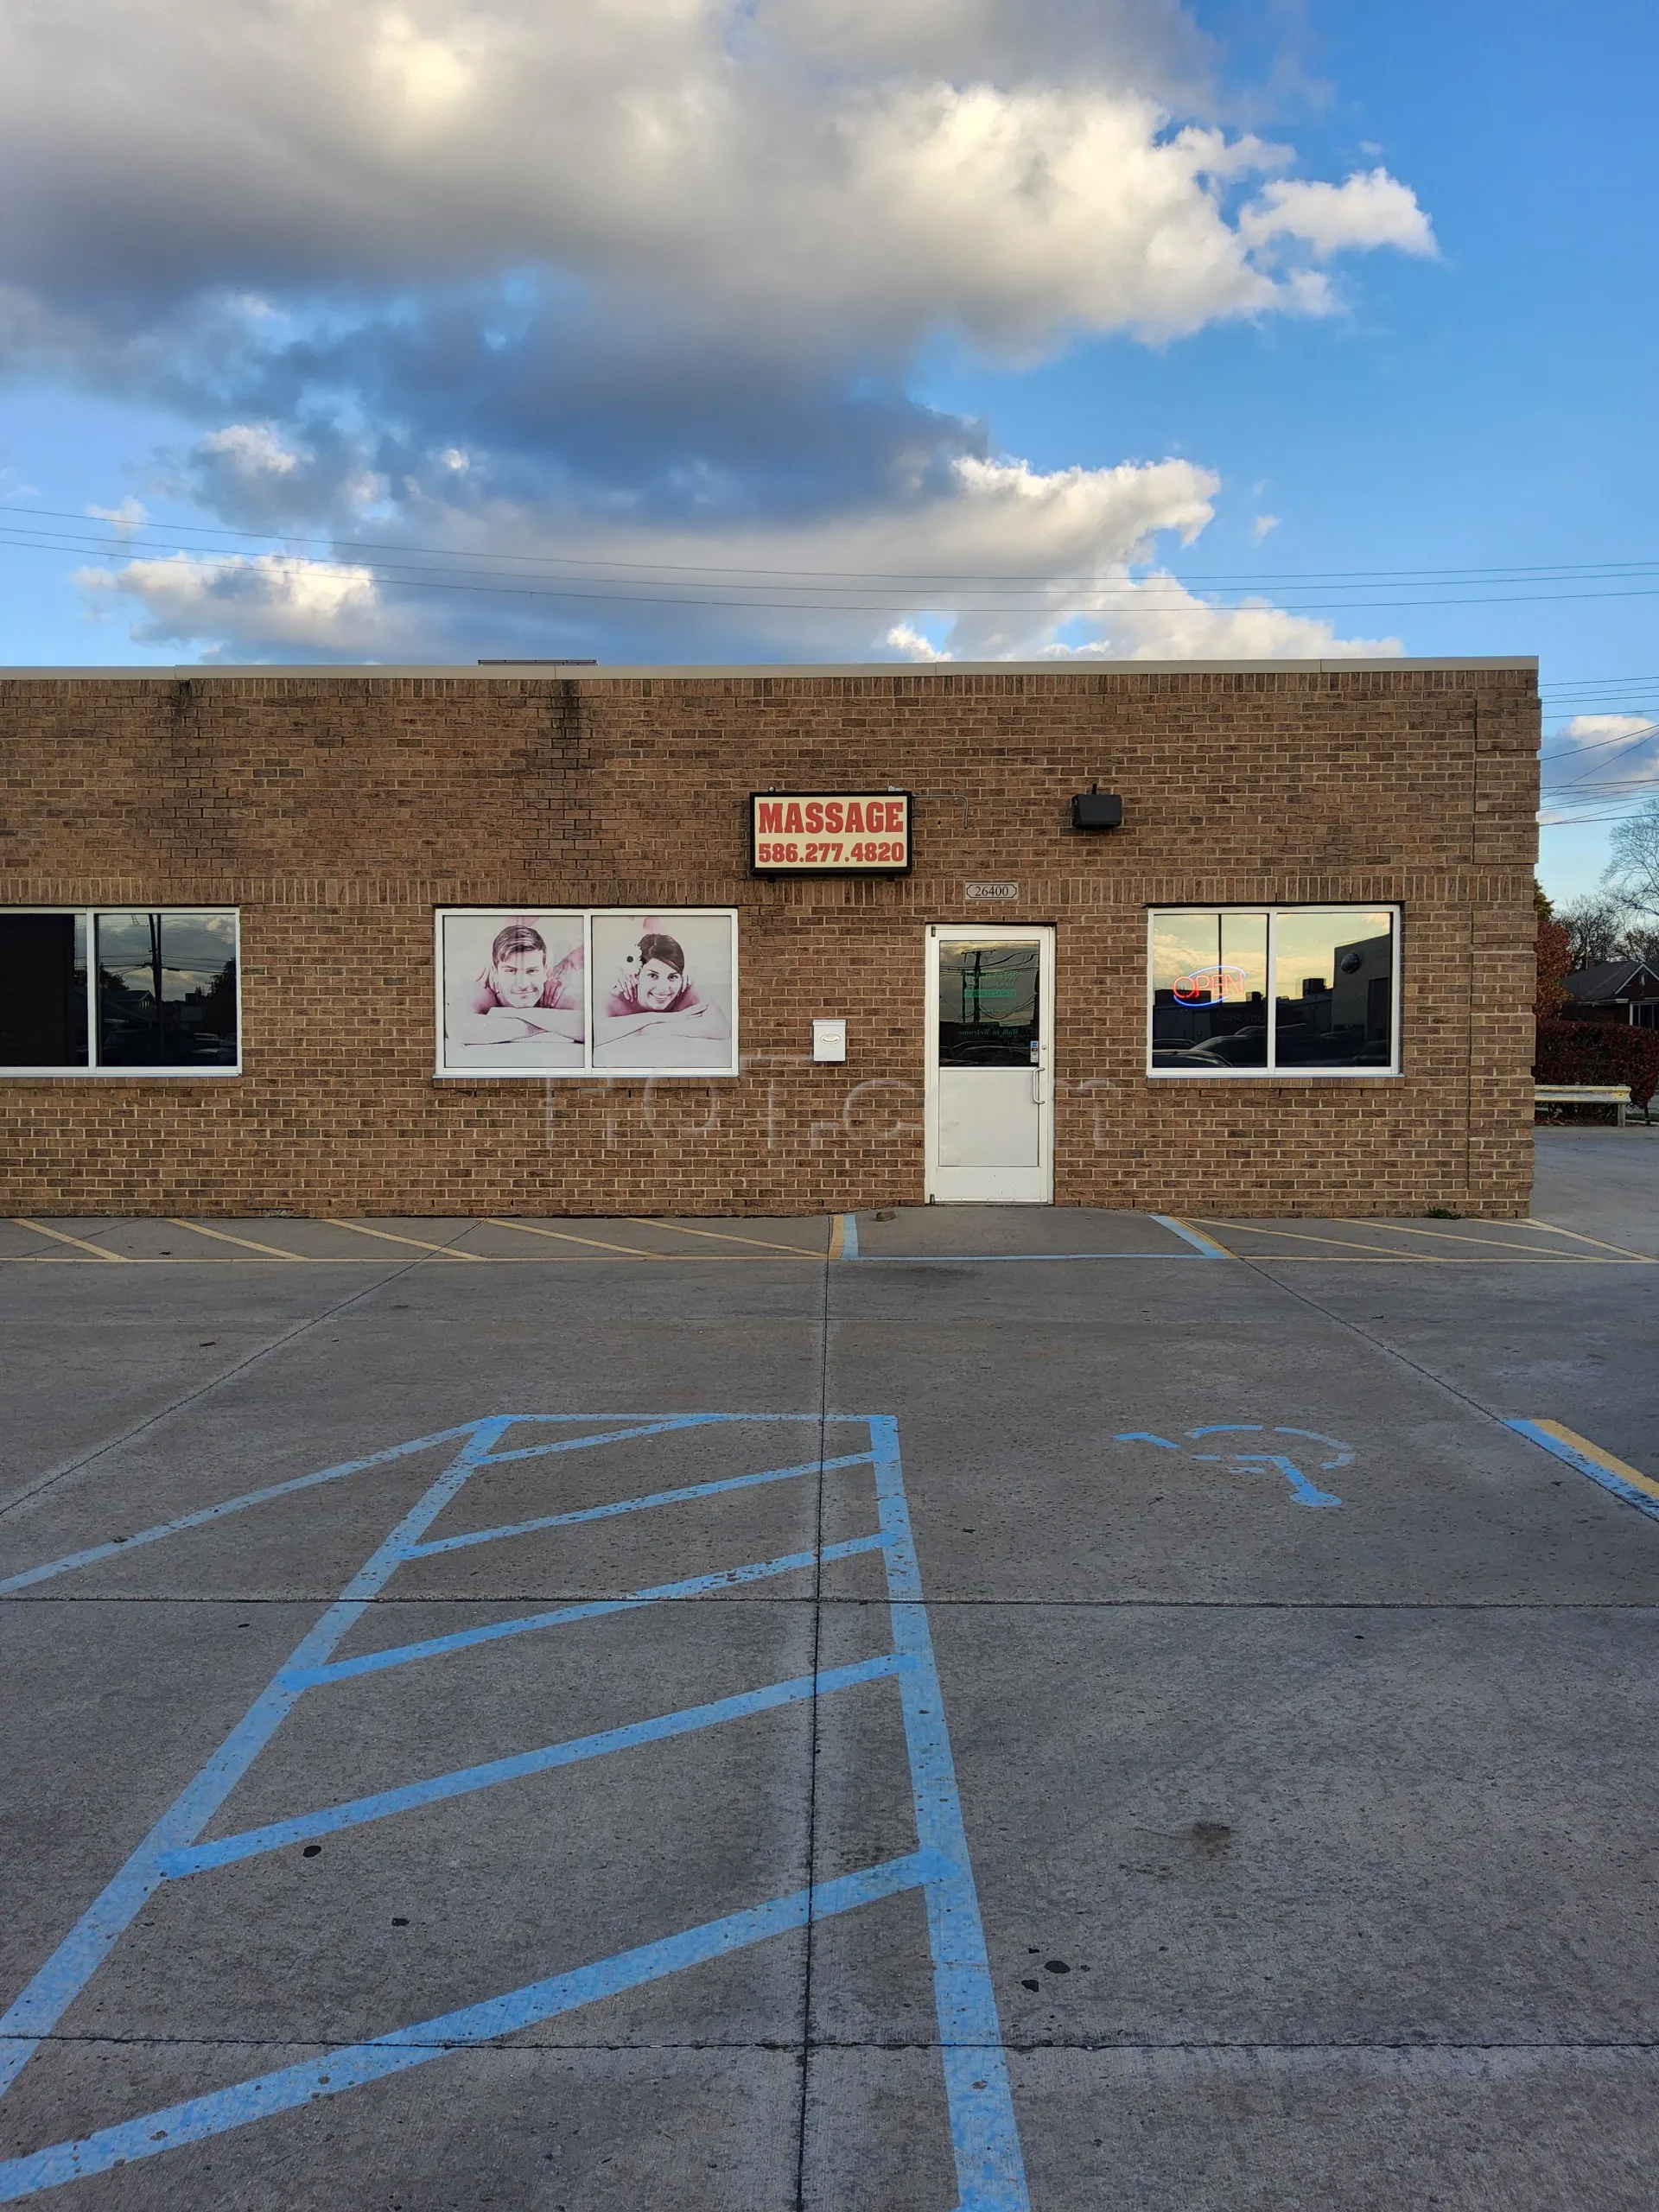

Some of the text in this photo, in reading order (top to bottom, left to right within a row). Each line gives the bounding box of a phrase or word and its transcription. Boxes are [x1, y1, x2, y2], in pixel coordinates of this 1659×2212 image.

[759, 802, 904, 834] MASSAGE
[759, 842, 905, 862] 586.277.4820
[975, 886, 1009, 897] 26400
[1173, 972, 1244, 999] OPEN
